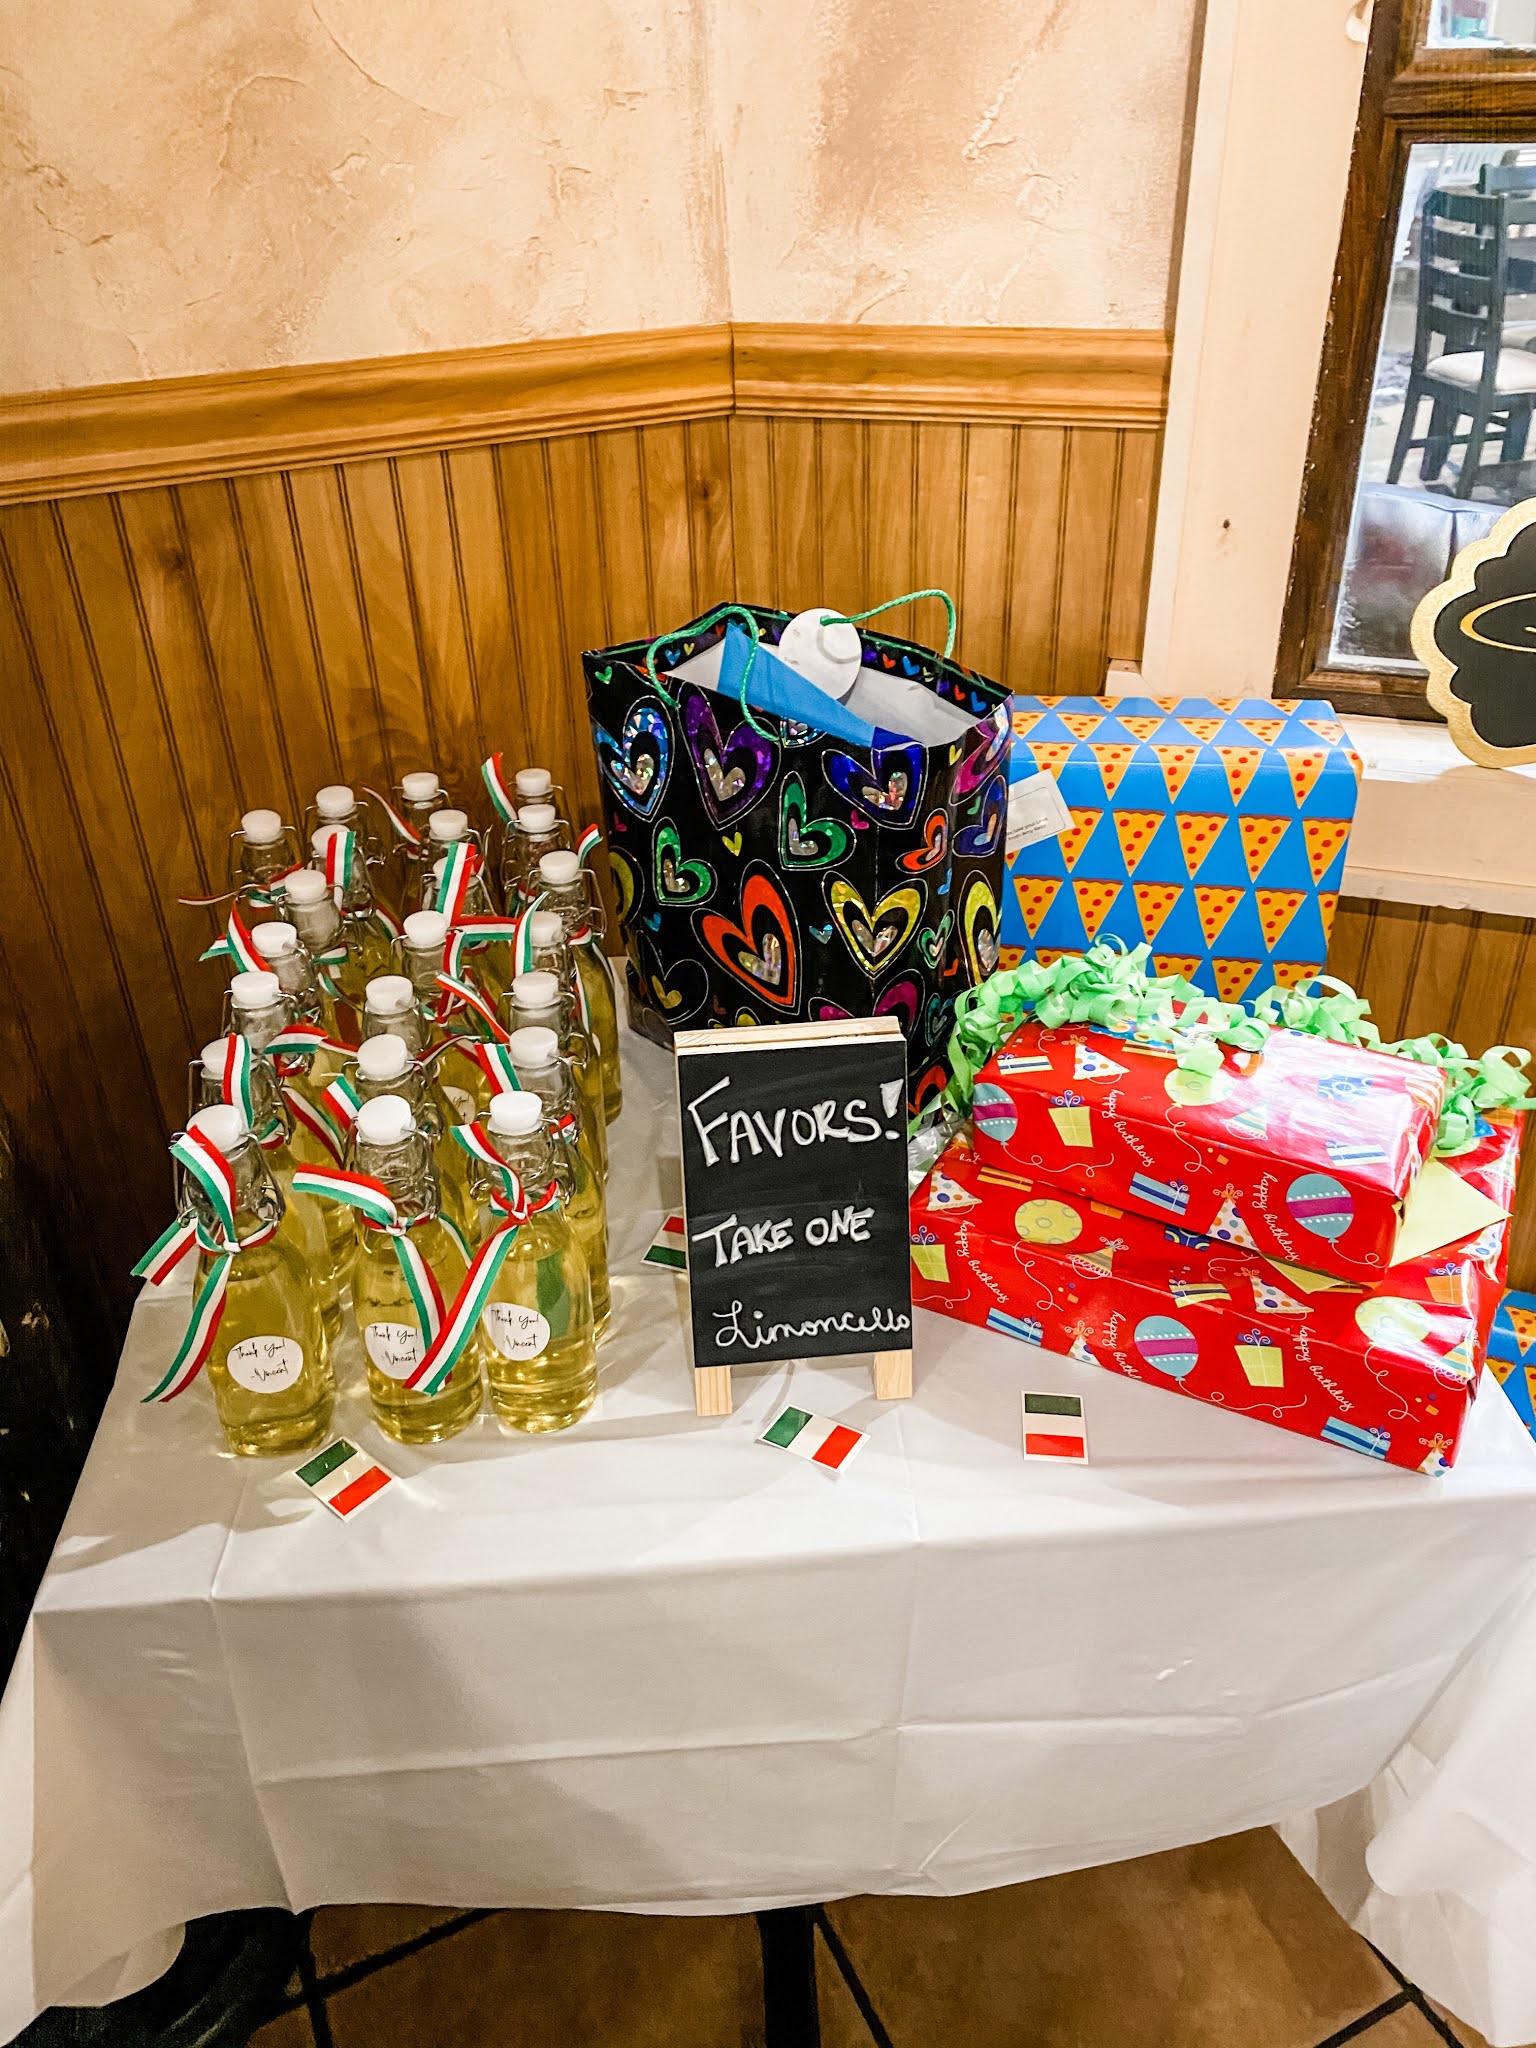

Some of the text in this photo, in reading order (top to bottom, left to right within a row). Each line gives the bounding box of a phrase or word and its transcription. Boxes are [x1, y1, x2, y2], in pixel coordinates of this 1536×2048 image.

[686, 1076, 904, 1167] FAVORS!
[1102, 1088, 1155, 1167] happy birthday
[692, 1206, 875, 1267] TAKE ONE
[1252, 1172, 1300, 1261] happy birthday
[954, 1220, 1009, 1303] happy birthday
[712, 1300, 910, 1349] Limoncello
[1102, 1310, 1126, 1349] happy
[1293, 1325, 1354, 1412] happy birthday
